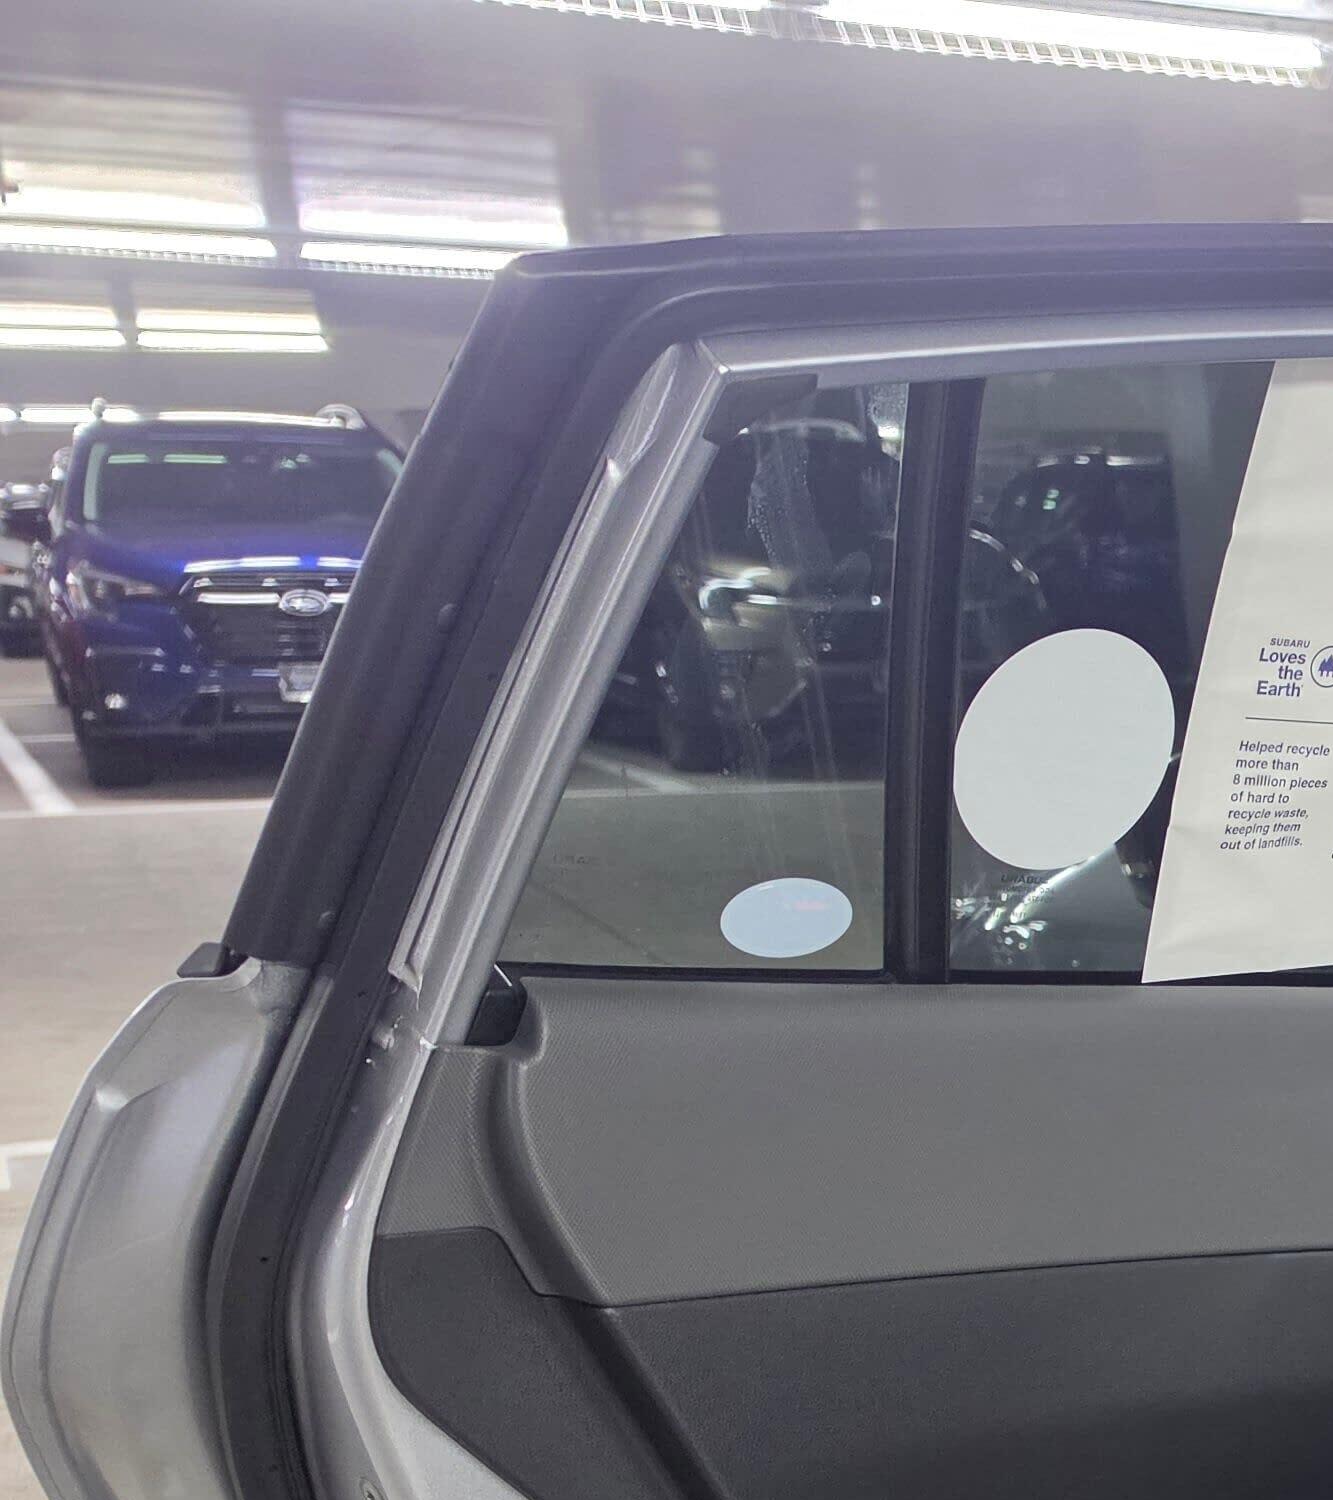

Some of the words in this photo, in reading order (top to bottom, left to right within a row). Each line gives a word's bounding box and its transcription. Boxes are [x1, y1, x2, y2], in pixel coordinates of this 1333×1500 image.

[1270, 638, 1311, 648] SUBARU
[1259, 647, 1307, 664] Loves
[1278, 666, 1303, 680] the
[1256, 680, 1301, 697] Earth
[1239, 740, 1283, 755] Helped
[1286, 744, 1330, 757] recycle
[1236, 759, 1268, 770] more
[1272, 759, 1299, 771] than
[1233, 774, 1240, 785] 8
[1244, 775, 1286, 788] million
[1290, 777, 1328, 790] pieces
[1230, 791, 1243, 802] of
[1248, 792, 1275, 804] hard
[1278, 793, 1290, 804] to
[1228, 808, 1271, 821] recycle
[1274, 809, 1309, 820] waste,
[1225, 822, 1270, 837] keeping
[1273, 823, 1301, 832] them
[1220, 840, 1241, 850] out
[1244, 839, 1256, 850] of
[1258, 838, 1303, 849] landfills.
